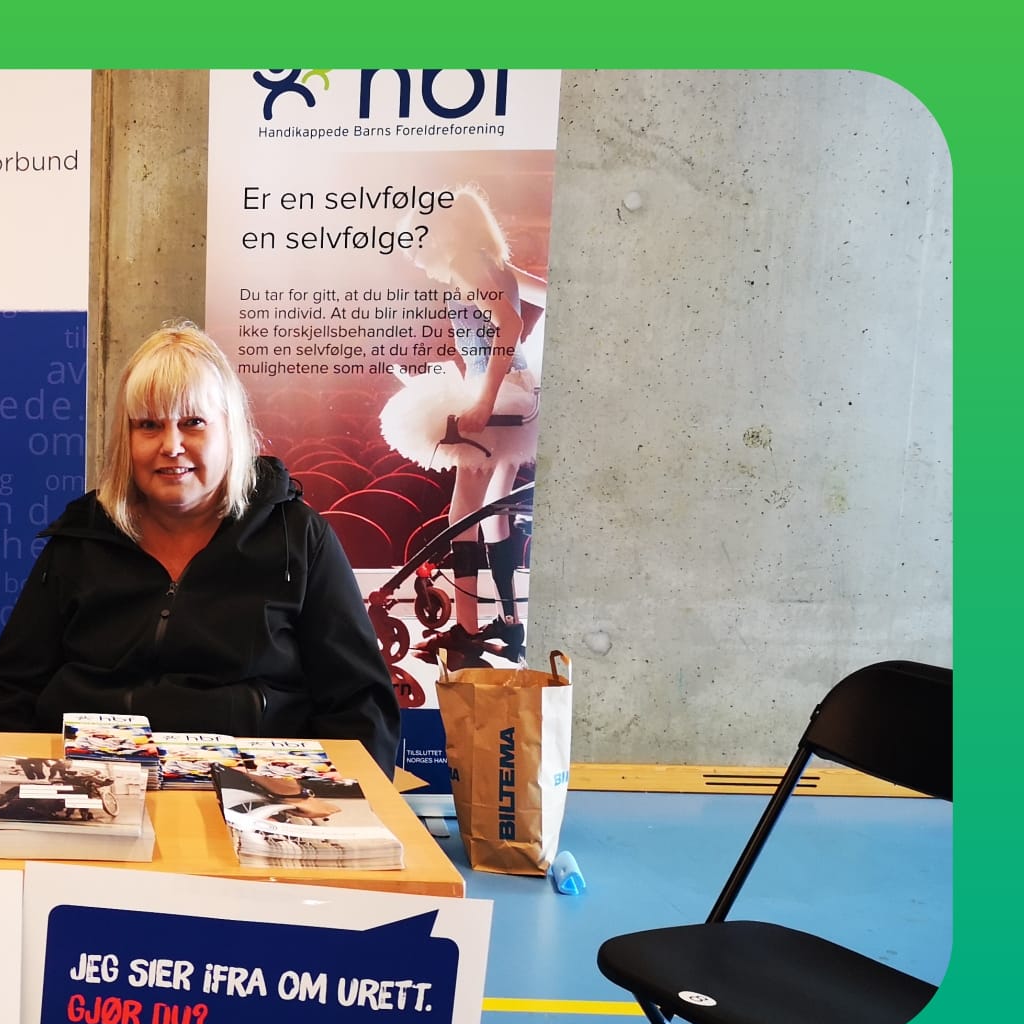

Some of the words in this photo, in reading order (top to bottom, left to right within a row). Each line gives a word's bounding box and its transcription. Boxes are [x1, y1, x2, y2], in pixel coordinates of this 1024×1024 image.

[258, 126, 349, 139] Handikappede
[354, 125, 391, 137] Barns
[396, 123, 505, 137] Foreldreforening
[243, 187, 271, 210] Er
[280, 191, 314, 210] en
[325, 186, 455, 215] selvfølge
[242, 231, 275, 250] en
[286, 226, 429, 255] selvfølge?
[240, 289, 260, 301] Du
[265, 290, 284, 301] tar
[289, 288, 308, 301] for
[313, 288, 339, 305] gitt,
[344, 289, 359, 301] at
[363, 288, 382, 301] du
[387, 288, 409, 301] blir
[414, 289, 438, 301] tatt
[443, 288, 462, 305] på
[467, 288, 504, 301] alvor
[239, 310, 270, 320] som
[274, 307, 326, 320] individ.
[331, 308, 347, 320] At
[351, 307, 370, 320] du
[375, 307, 398, 320] blir
[402, 307, 468, 320] inkludert
[473, 309, 492, 323] og
[64, 325, 85, 349] til
[239, 325, 269, 338] ikke
[273, 325, 417, 341] forskjellsbehandlet.
[422, 326, 443, 338] Du
[448, 327, 471, 338] ser
[476, 325, 500, 338] det
[238, 346, 268, 356] som
[273, 346, 291, 356] en
[296, 343, 367, 359] selvfølge,
[371, 345, 385, 356] at
[389, 343, 408, 356] du
[413, 342, 432, 356] får
[437, 343, 455, 356] de
[461, 346, 515, 357] samme
[47, 361, 85, 385] av
[238, 362, 328, 378] mulighetene
[333, 364, 364, 375] som
[369, 362, 395, 375] alle
[399, 362, 446, 375] andre.
[28, 432, 83, 456] om
[45, 473, 83, 491] om
[499, 727, 516, 840] BILTEMA
[70, 953, 119, 984] JEG
[128, 958, 194, 991] SIER
[278, 971, 327, 1005] OM
[337, 977, 433, 1012] URETT.
